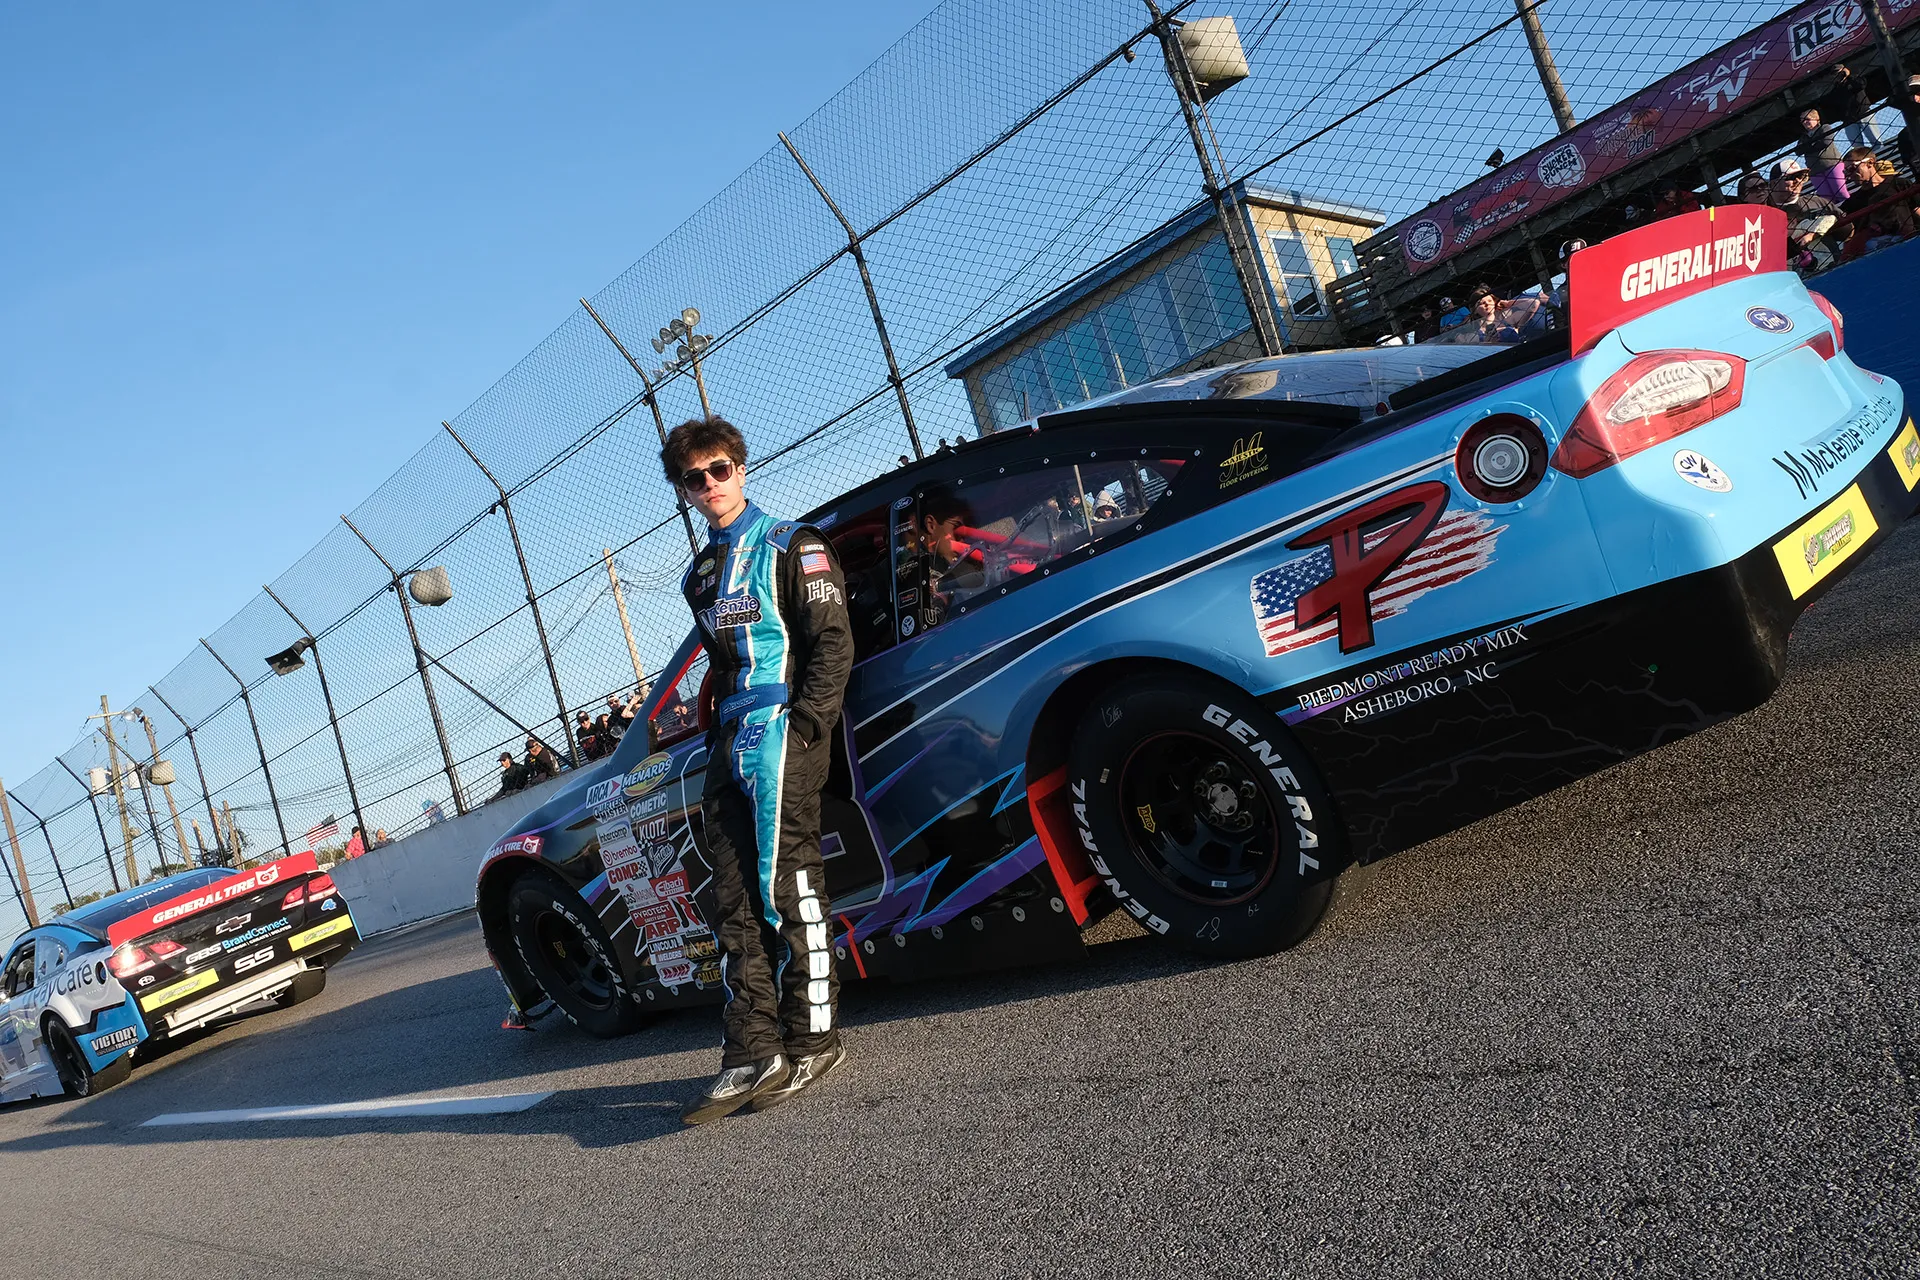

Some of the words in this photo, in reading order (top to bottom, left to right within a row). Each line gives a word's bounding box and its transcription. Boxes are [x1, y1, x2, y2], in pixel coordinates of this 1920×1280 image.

[1670, 39, 1770, 100] TRACK
[1699, 67, 1750, 113] TV
[1542, 149, 1576, 175] SUCKER
[1544, 158, 1579, 183] PUNCH
[1621, 243, 1713, 302] GENERAL
[1714, 234, 1745, 273] TIRE
[1754, 312, 1786, 330] Ford
[1801, 424, 1864, 479] McKenzie
[1219, 477, 1239, 489] FLOOR
[1239, 464, 1269, 481] COVERING
[806, 578, 842, 605] HPU
[1297, 662, 1405, 711] PIEDMONT
[1407, 639, 1480, 677] READY
[1482, 624, 1529, 653] MIX
[1343, 675, 1458, 723] ASHEBORO,
[1465, 661, 1500, 686] NC
[735, 721, 768, 752] 95
[622, 758, 673, 789] MENARDS
[587, 780, 611, 806] ARCA
[1202, 703, 1320, 876] GENERAL
[594, 797, 623, 819] QUARTER
[599, 804, 628, 821] MASTER
[630, 792, 667, 818] COMETIC
[639, 818, 666, 841] KLOTZ
[502, 842, 522, 852] TIRE
[611, 845, 638, 861] brembo
[1072, 779, 1170, 935] GENERAL
[608, 862, 639, 885] COMP
[126, 883, 173, 903] BROWN
[656, 876, 684, 897] Eibach
[152, 892, 223, 924] GENERAL
[224, 877, 255, 898] TIRE
[321, 898, 337, 911] 4
[633, 904, 670, 919] PYROTECT
[186, 942, 221, 965] GBS
[221, 916, 289, 950] BrandConnect
[646, 918, 681, 939] ARP
[649, 938, 678, 953] LINCOLN
[658, 950, 682, 962] WELDERS
[796, 869, 831, 1033] LONDON
[234, 945, 275, 974] SS
[697, 968, 722, 984] CALLIE
[91, 1025, 138, 1050] VICTORY
